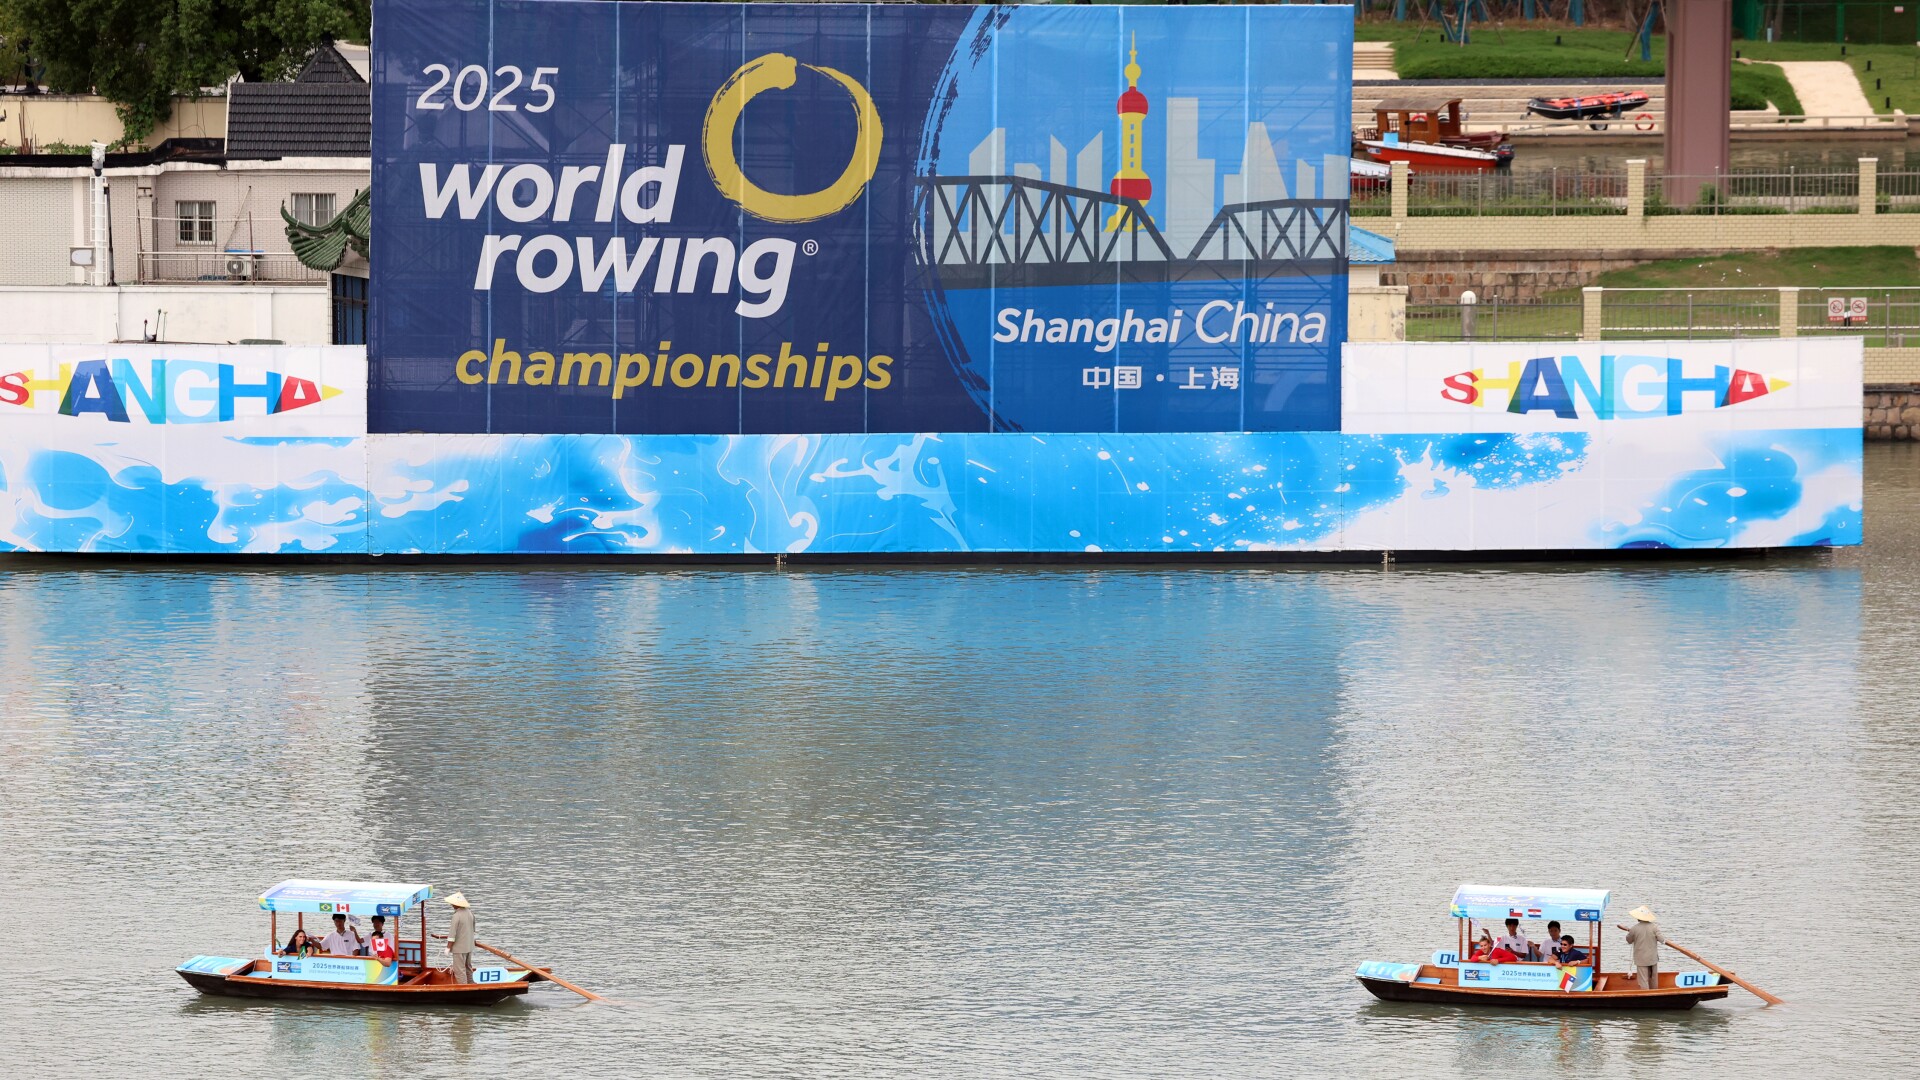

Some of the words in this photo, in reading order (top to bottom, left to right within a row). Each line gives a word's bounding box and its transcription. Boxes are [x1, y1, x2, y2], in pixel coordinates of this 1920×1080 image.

[416, 63, 558, 113] 2025
[418, 143, 686, 223] world
[992, 307, 1184, 353] Shanghai
[1195, 300, 1327, 344] China
[456, 338, 894, 402] championships
[480, 970, 501, 982] 03
[1684, 974, 1706, 986] 04
